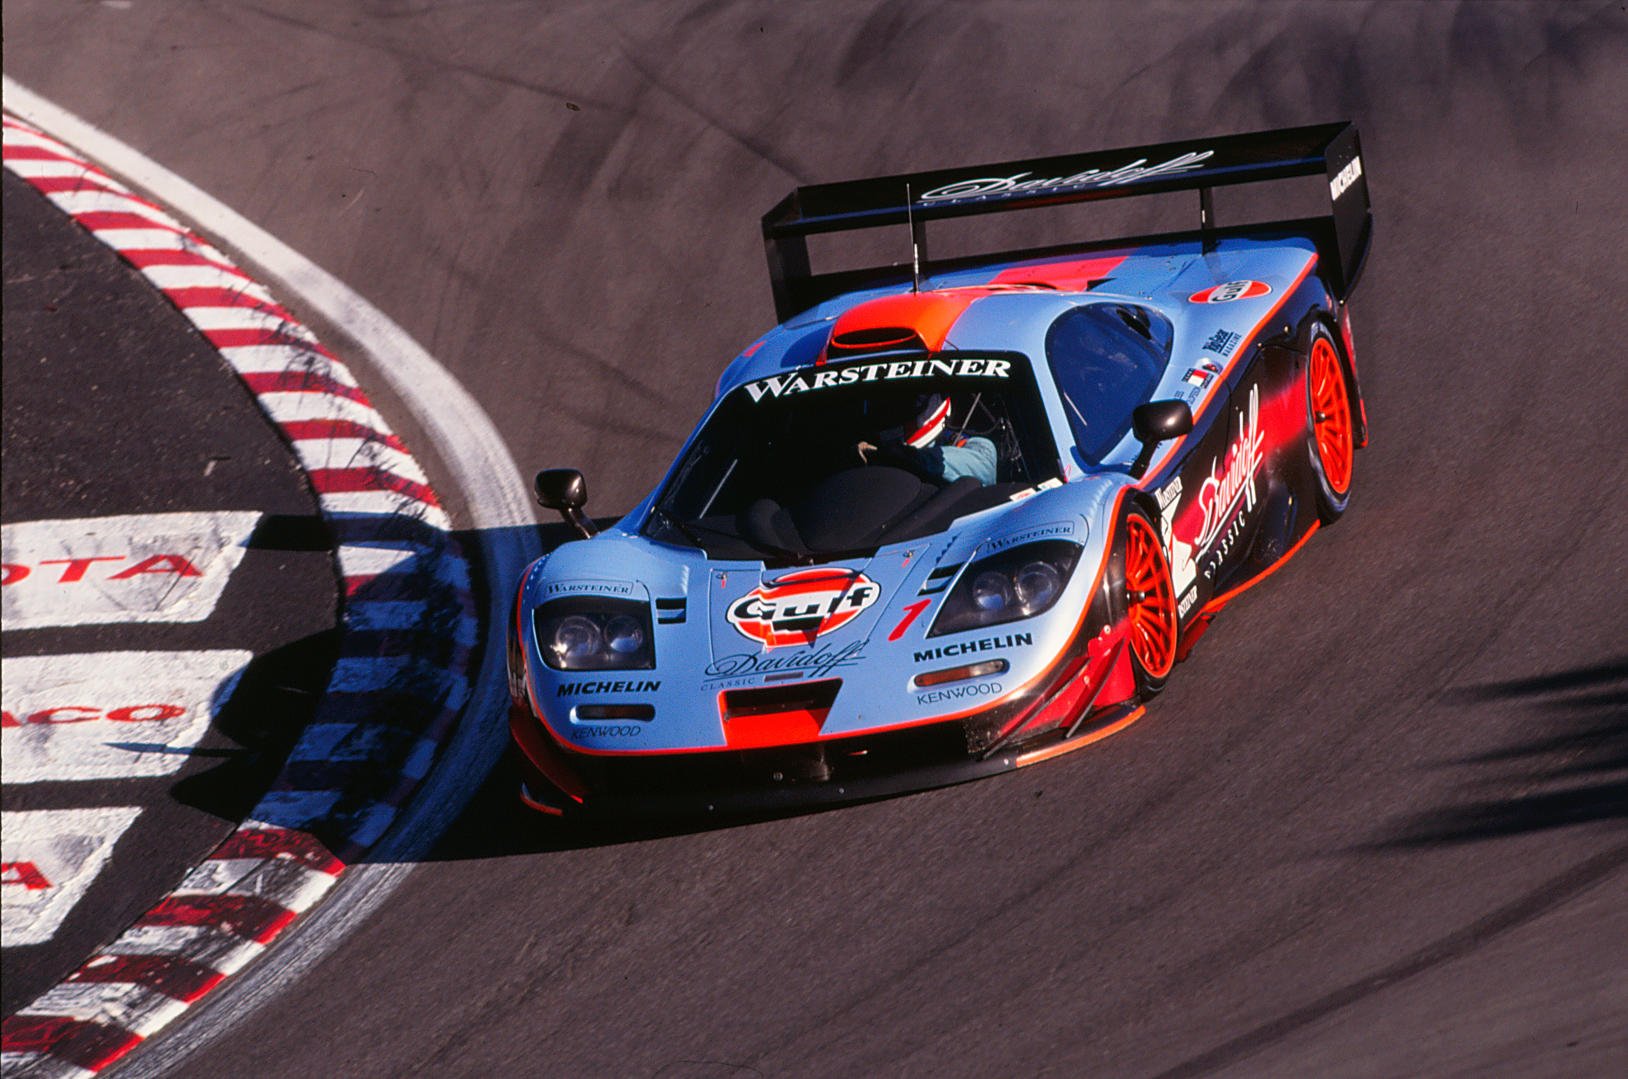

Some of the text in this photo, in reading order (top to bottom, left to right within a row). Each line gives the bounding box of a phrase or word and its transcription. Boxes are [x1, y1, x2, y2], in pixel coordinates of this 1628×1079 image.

[744, 359, 1011, 402] WARSTEINER
[733, 586, 873, 621] Gulf
[888, 598, 932, 642] 1
[704, 639, 870, 678] Davidoff
[913, 632, 1034, 663] MICHELIN
[557, 680, 662, 697] MICHELIN
[700, 677, 756, 692] CLASSIC
[916, 682, 1003, 706] KENWOOD
[2, 704, 187, 728] CO
[571, 725, 641, 741] KENWOOD
